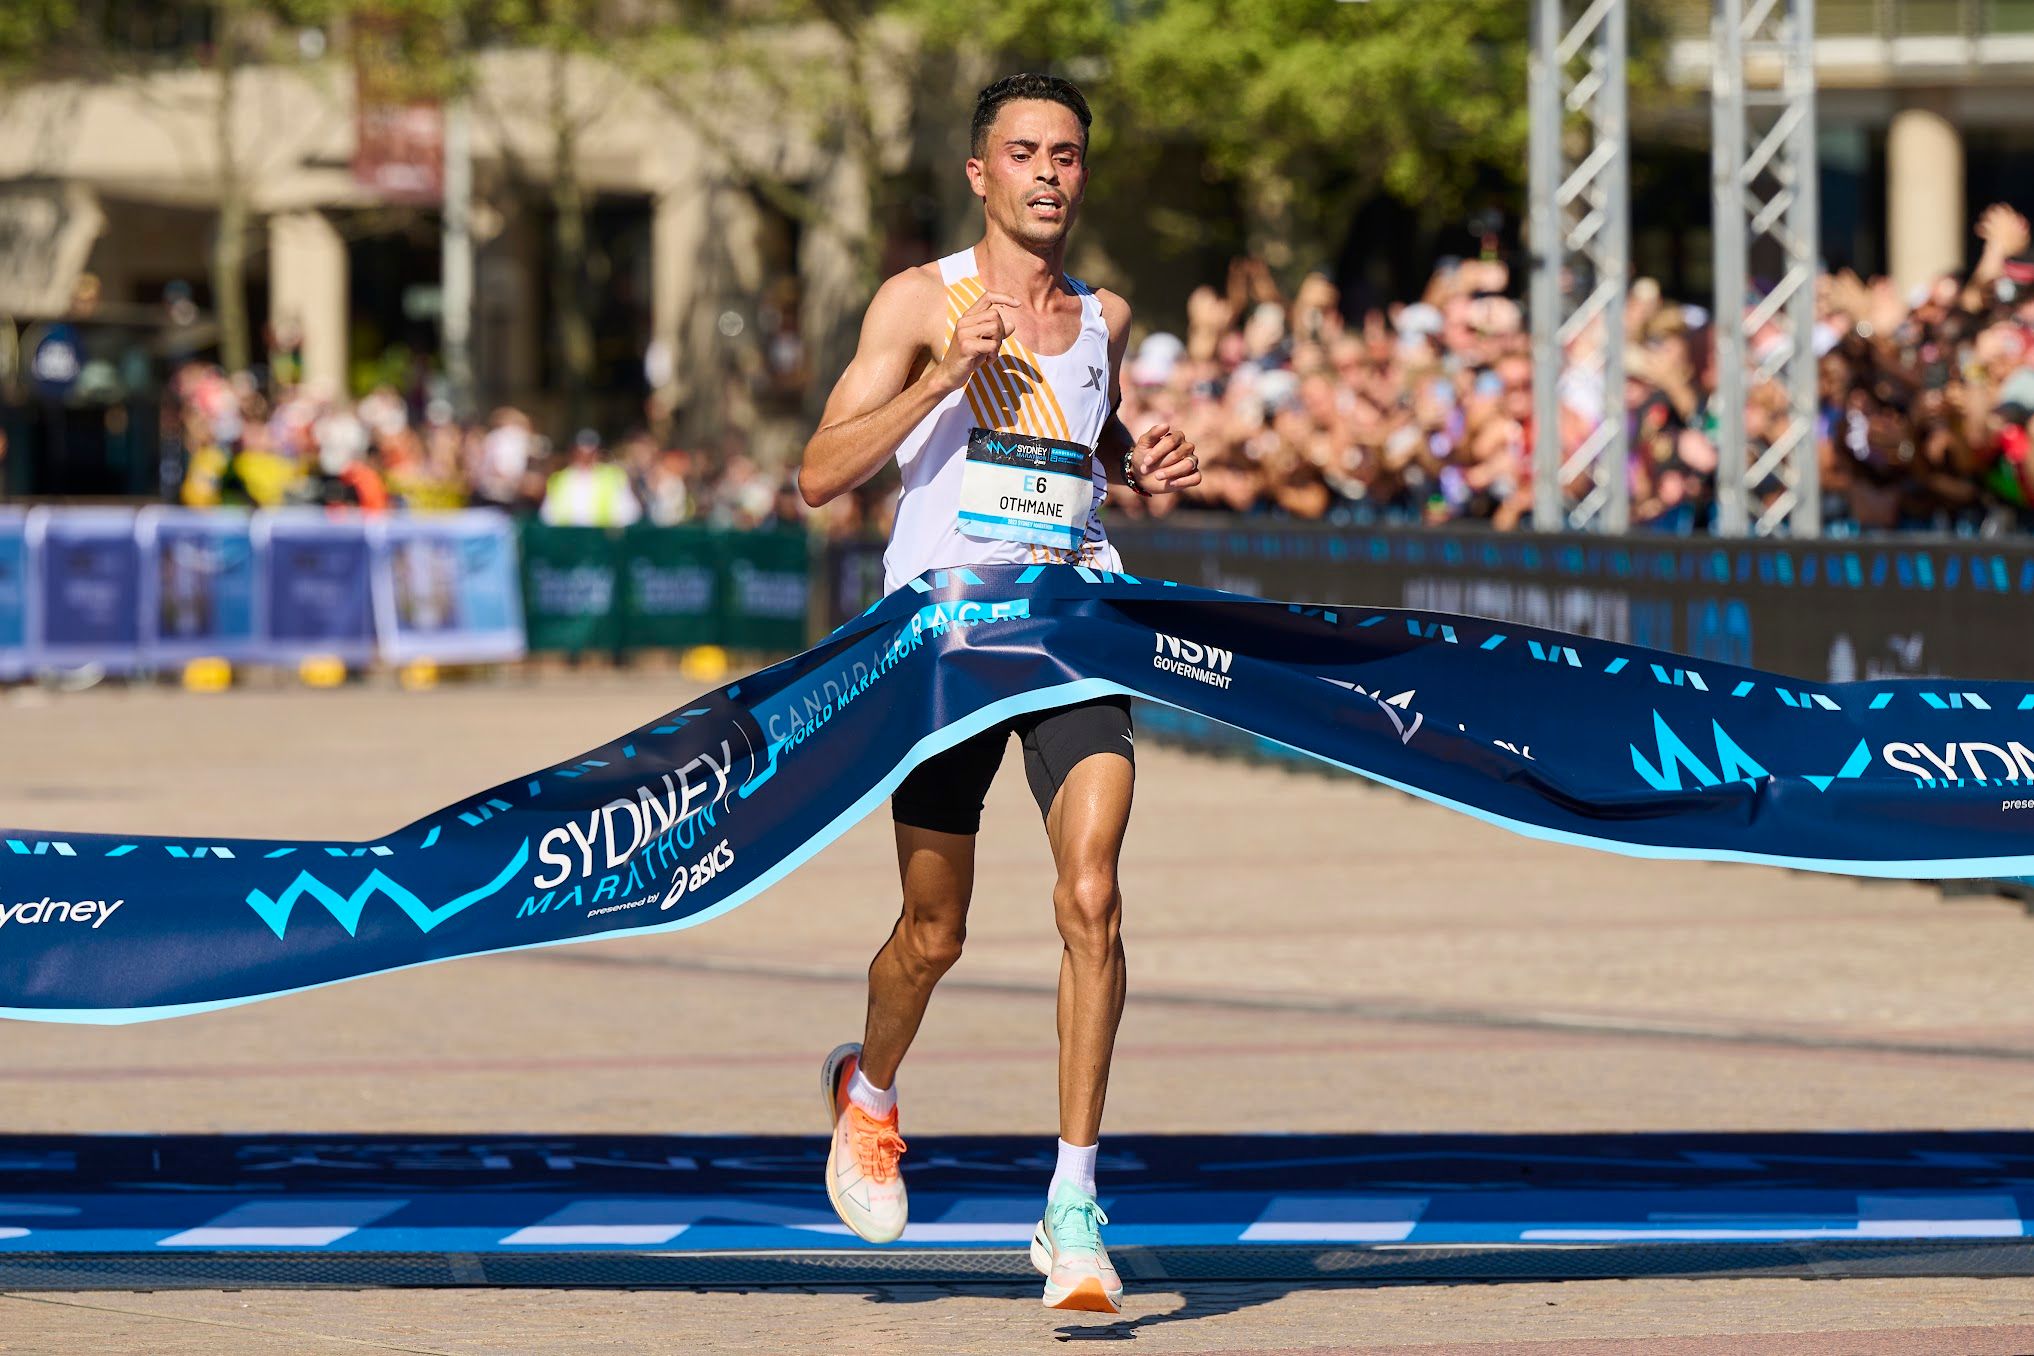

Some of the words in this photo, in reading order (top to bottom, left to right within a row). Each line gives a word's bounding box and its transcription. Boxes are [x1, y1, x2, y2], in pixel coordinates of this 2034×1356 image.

[1017, 444, 1048, 456] SYDNEY
[1023, 475, 1047, 493] E6
[1000, 496, 1064, 518] OTHMANE
[1155, 632, 1233, 673] NSW
[1153, 655, 1233, 690] GOVERNMENT
[785, 704, 832, 754] WORLD
[837, 635, 924, 710] MARATHON
[533, 739, 731, 889] SYDNEY
[515, 802, 717, 919] MARATHON
[587, 897, 646, 919] presented
[646, 892, 660, 904] by
